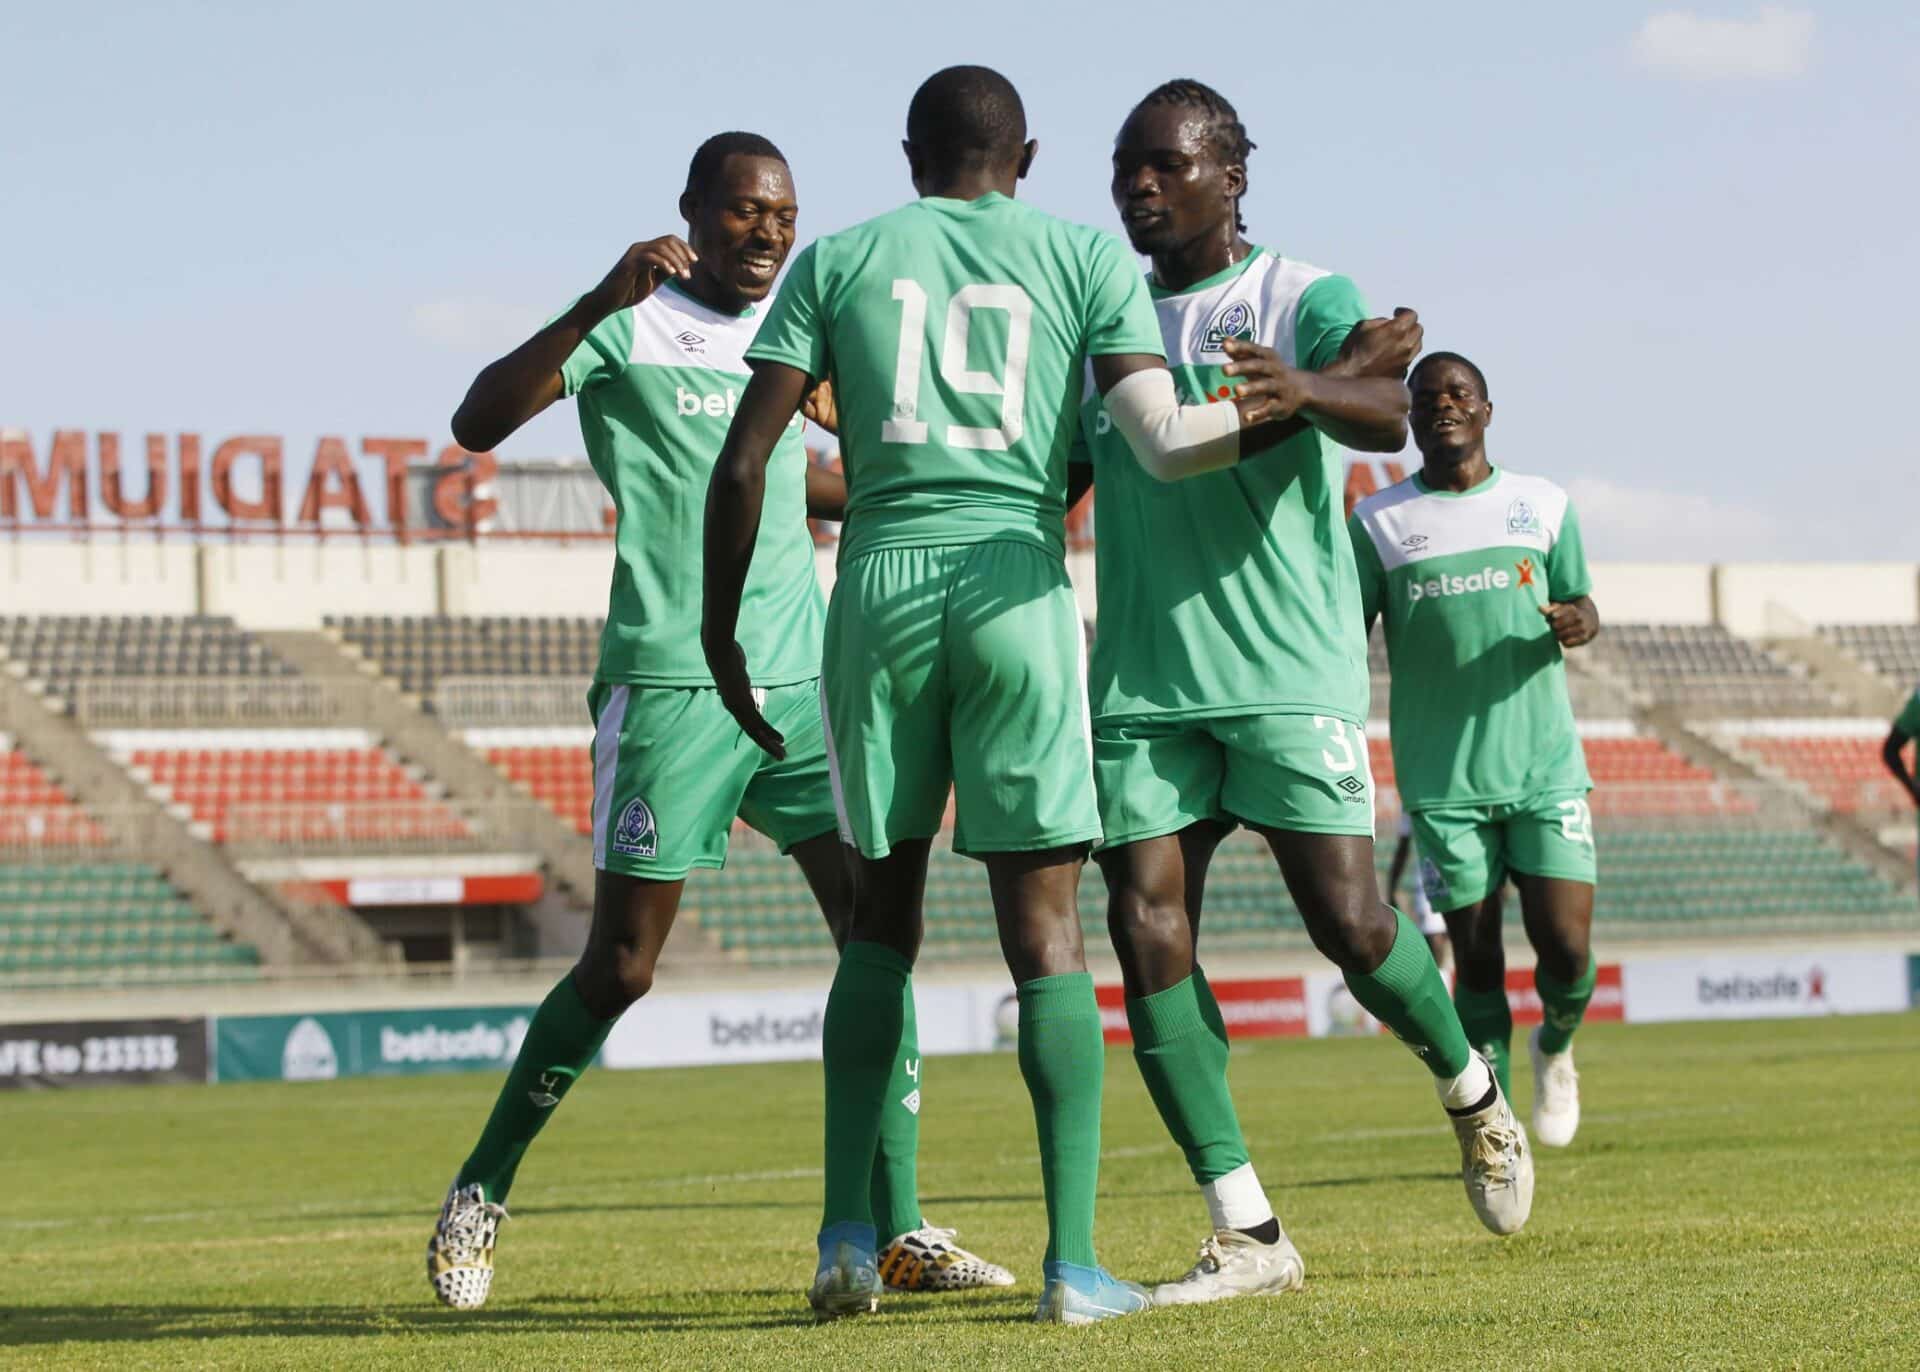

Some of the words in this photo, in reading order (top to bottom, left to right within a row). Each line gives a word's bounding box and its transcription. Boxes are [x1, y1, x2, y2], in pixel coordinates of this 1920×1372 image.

[881, 279, 1033, 451] 19
[1407, 567, 1510, 601] betsafe
[1698, 972, 1799, 1003] betsafe
[381, 1020, 504, 1063] betsafe
[708, 1010, 822, 1046] betsaf
[43, 1041, 81, 1073] to
[905, 1058, 919, 1083] 4
[541, 1072, 559, 1092] 4
